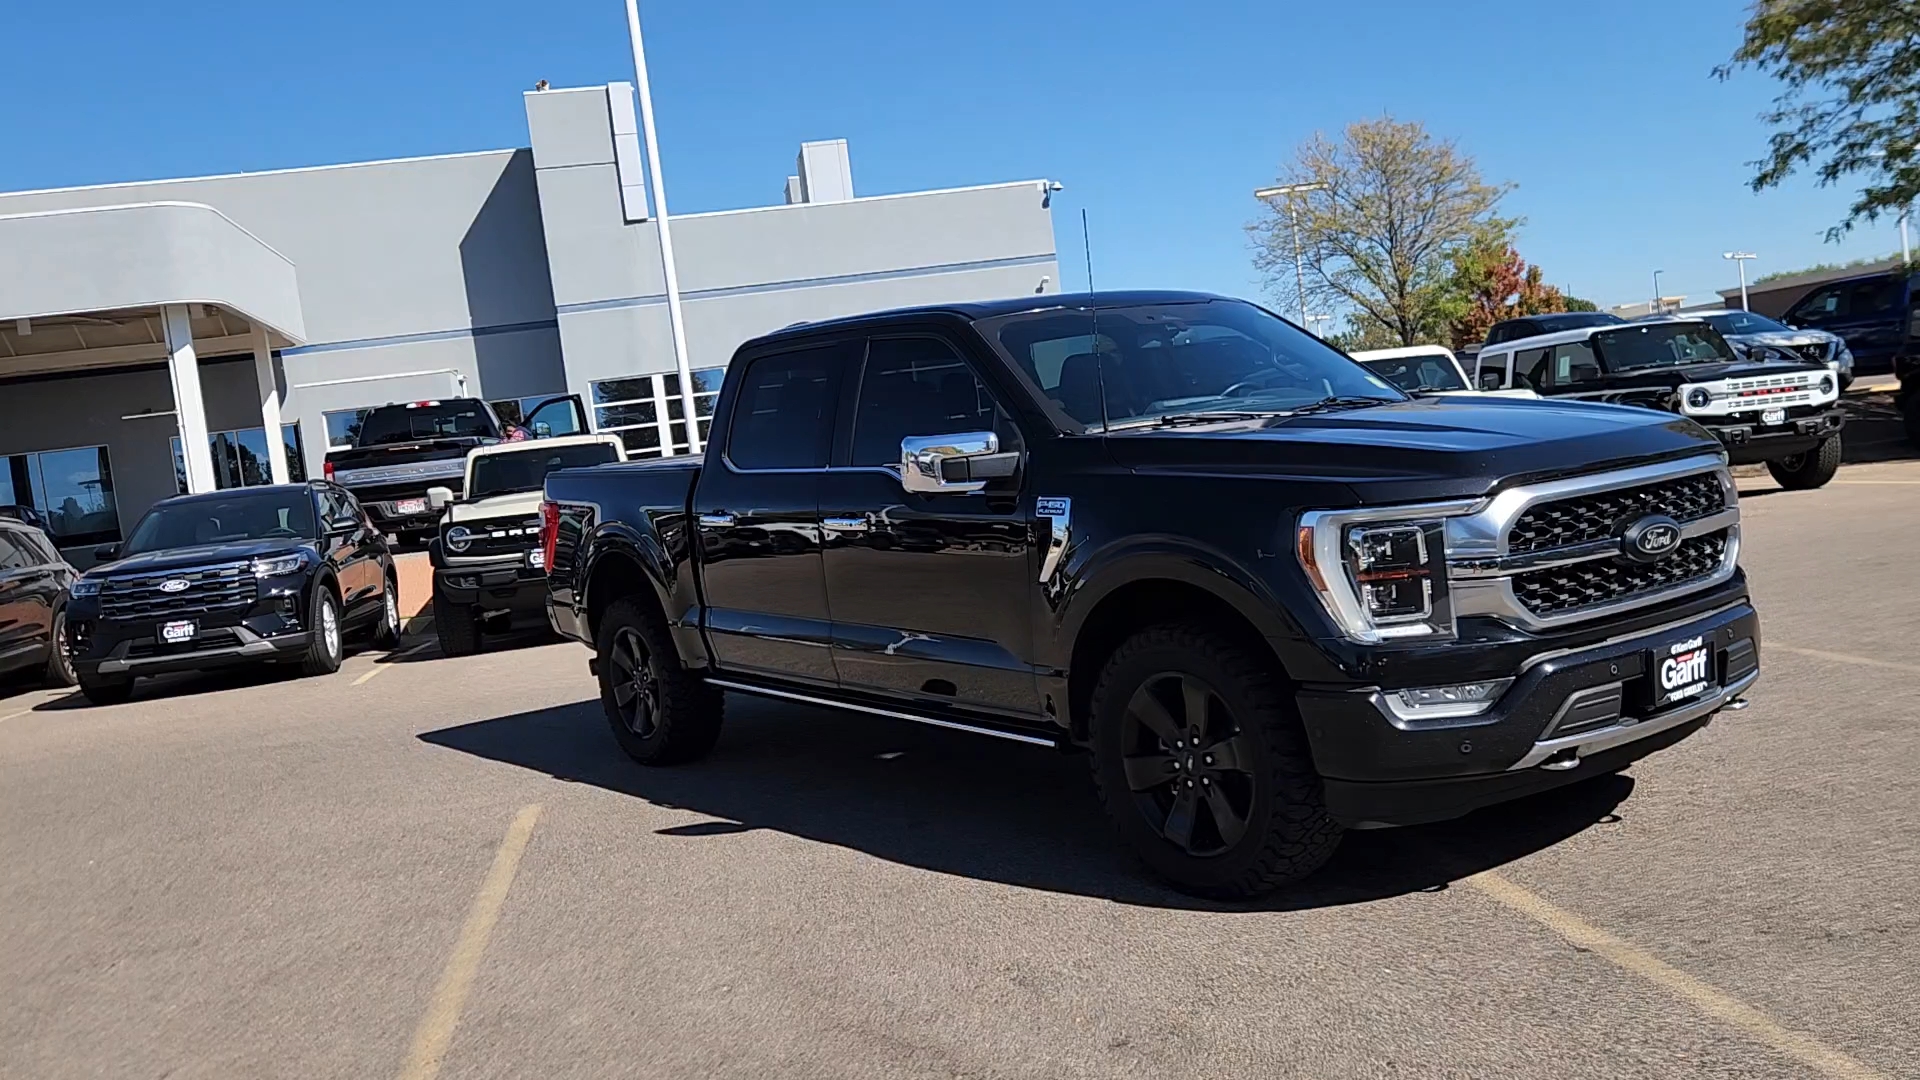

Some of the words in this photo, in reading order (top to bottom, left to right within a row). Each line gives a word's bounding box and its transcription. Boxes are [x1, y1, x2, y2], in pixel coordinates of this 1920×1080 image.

[1645, 528, 1672, 549] Ford
[163, 624, 195, 638] Garff
[1661, 648, 1707, 690] Garff
